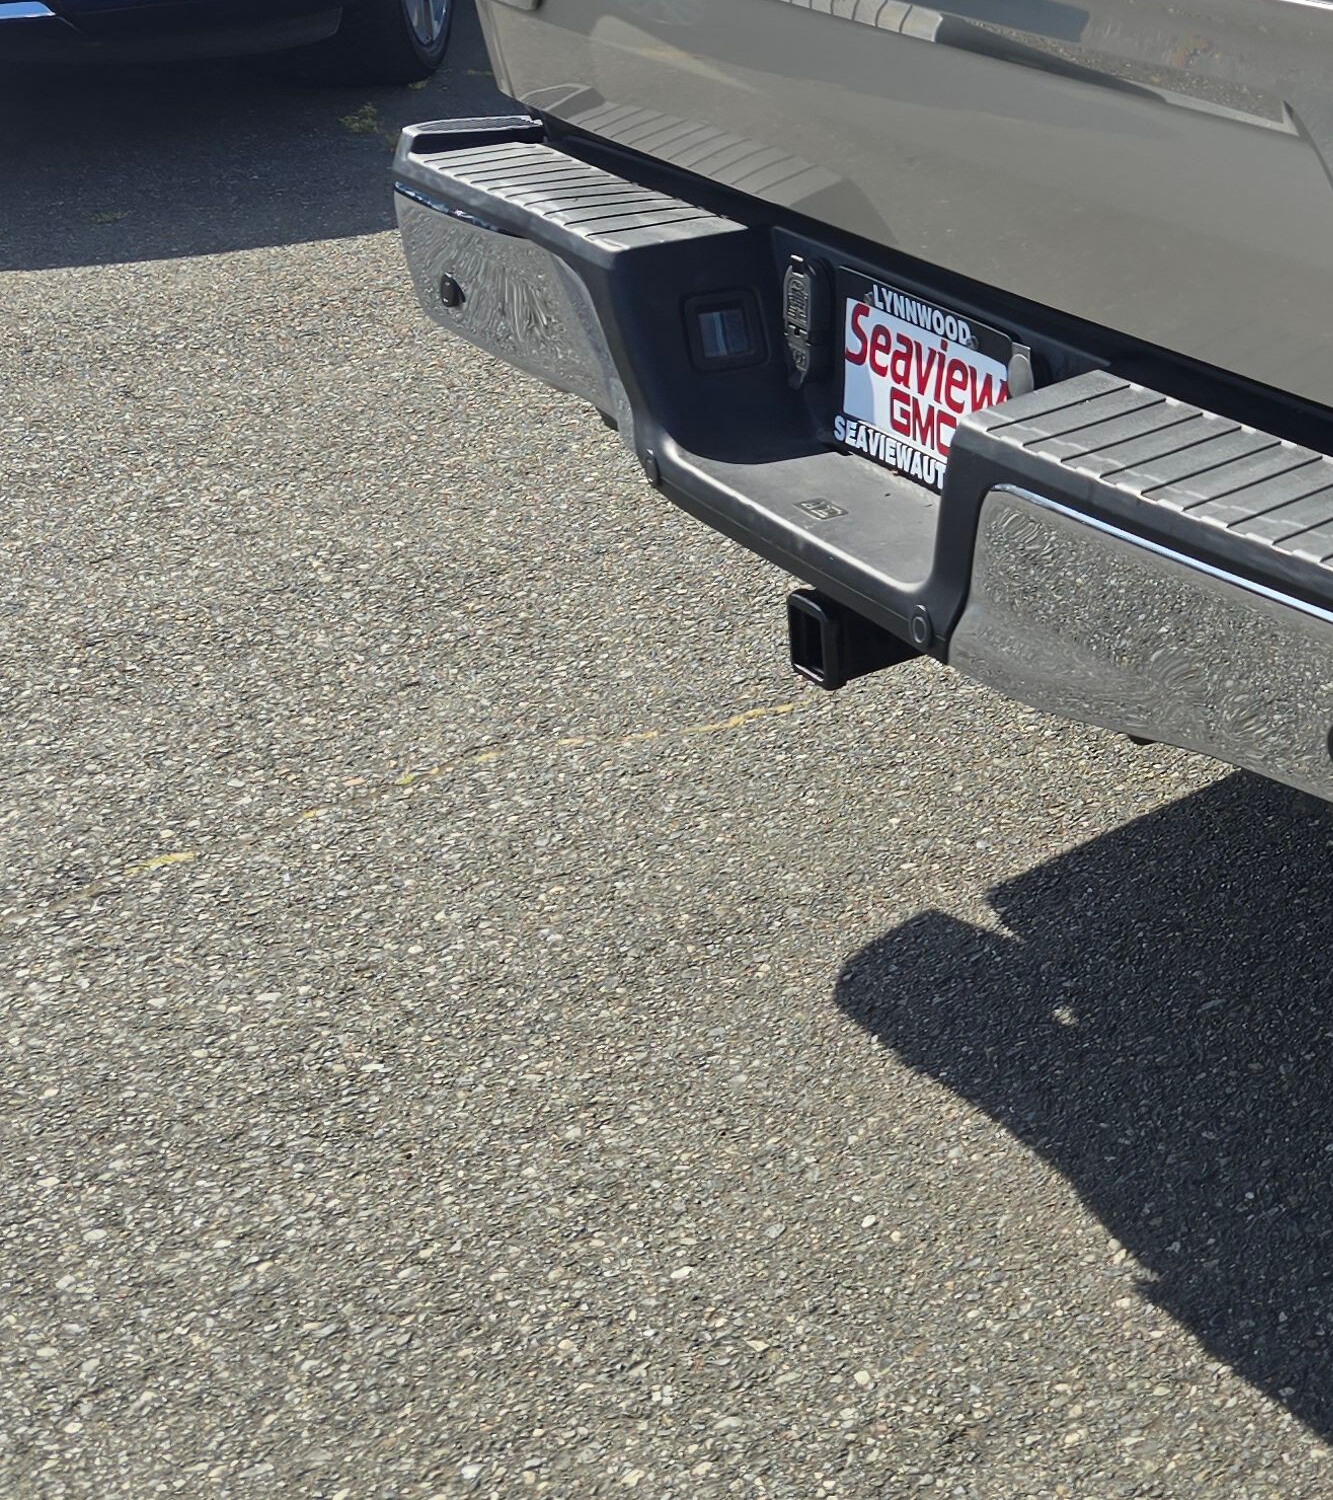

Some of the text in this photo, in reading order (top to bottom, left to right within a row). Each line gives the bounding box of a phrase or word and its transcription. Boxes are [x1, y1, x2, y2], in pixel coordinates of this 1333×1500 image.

[872, 284, 973, 346] LYNNWOOD
[845, 302, 1009, 414] Seaview
[890, 386, 957, 455] GMC
